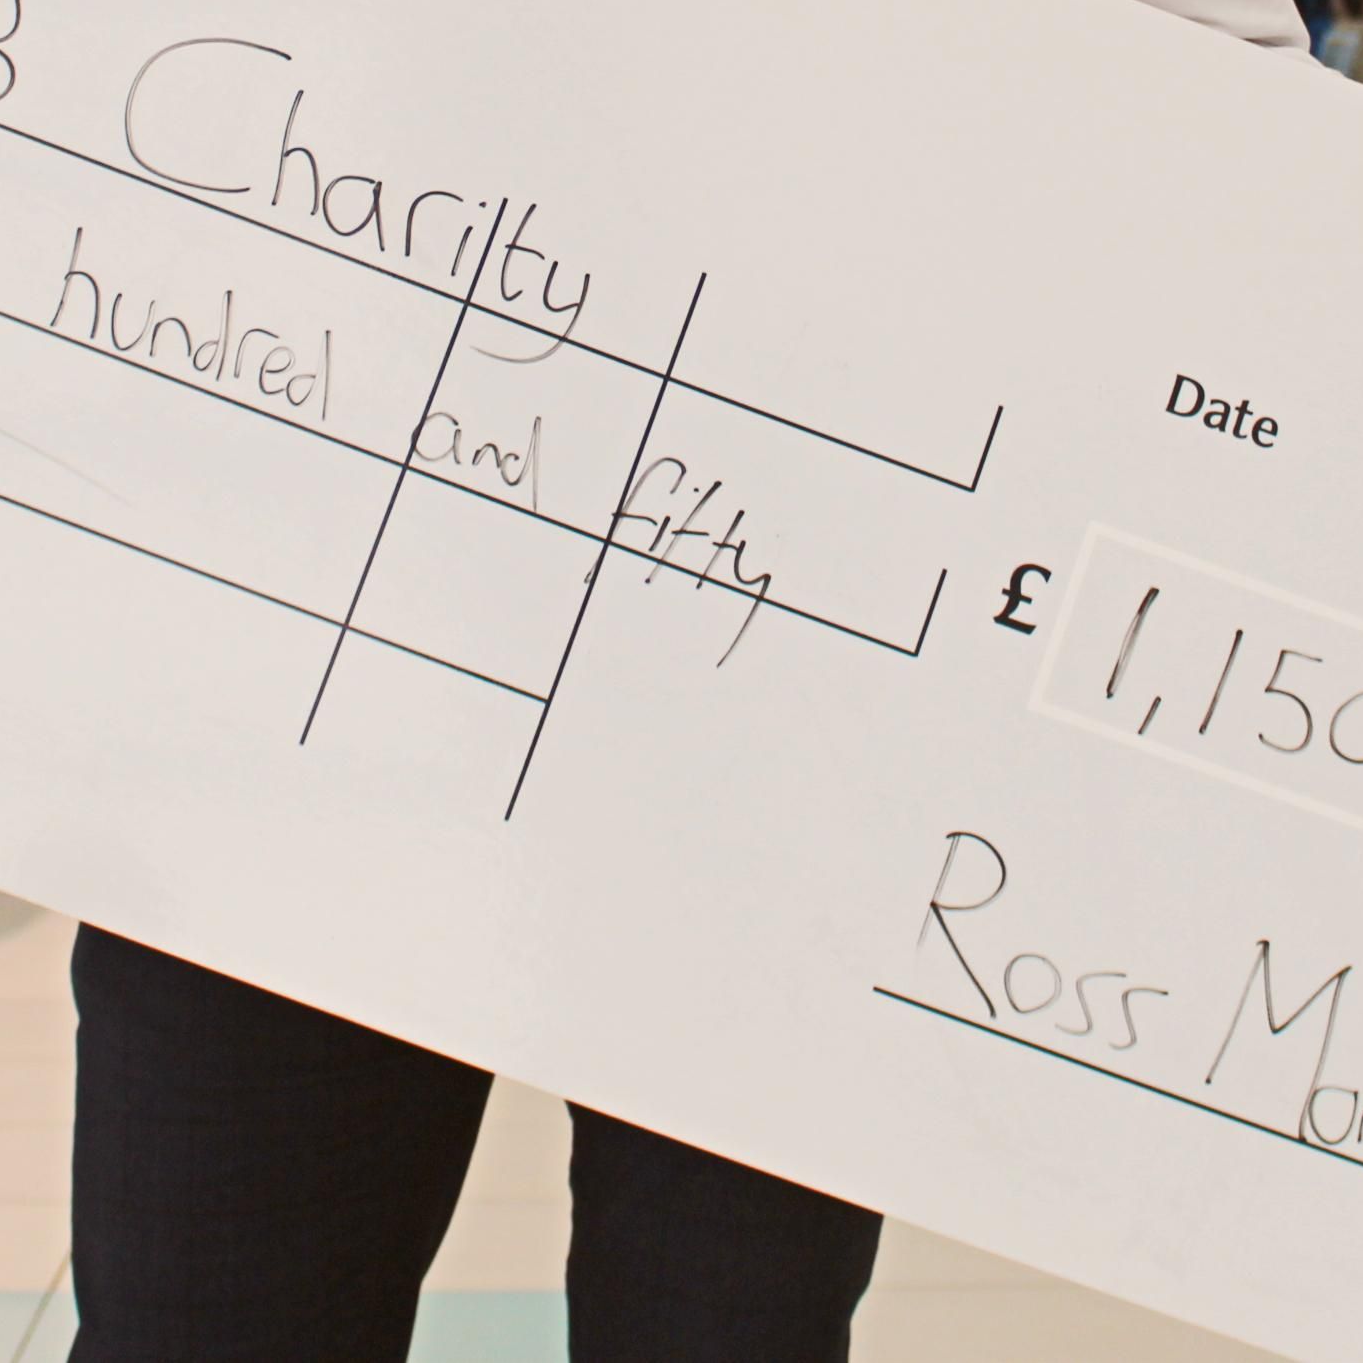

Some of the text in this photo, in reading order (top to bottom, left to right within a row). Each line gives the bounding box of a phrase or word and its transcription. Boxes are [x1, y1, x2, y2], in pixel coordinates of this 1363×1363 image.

[125, 38, 590, 363] Charity
[50, 226, 332, 420] hundred
[411, 412, 542, 511] and
[584, 457, 771, 668] fifty
[1165, 373, 1279, 448] Date
[993, 563, 1052, 635] £
[917, 831, 1168, 1050] Ross
